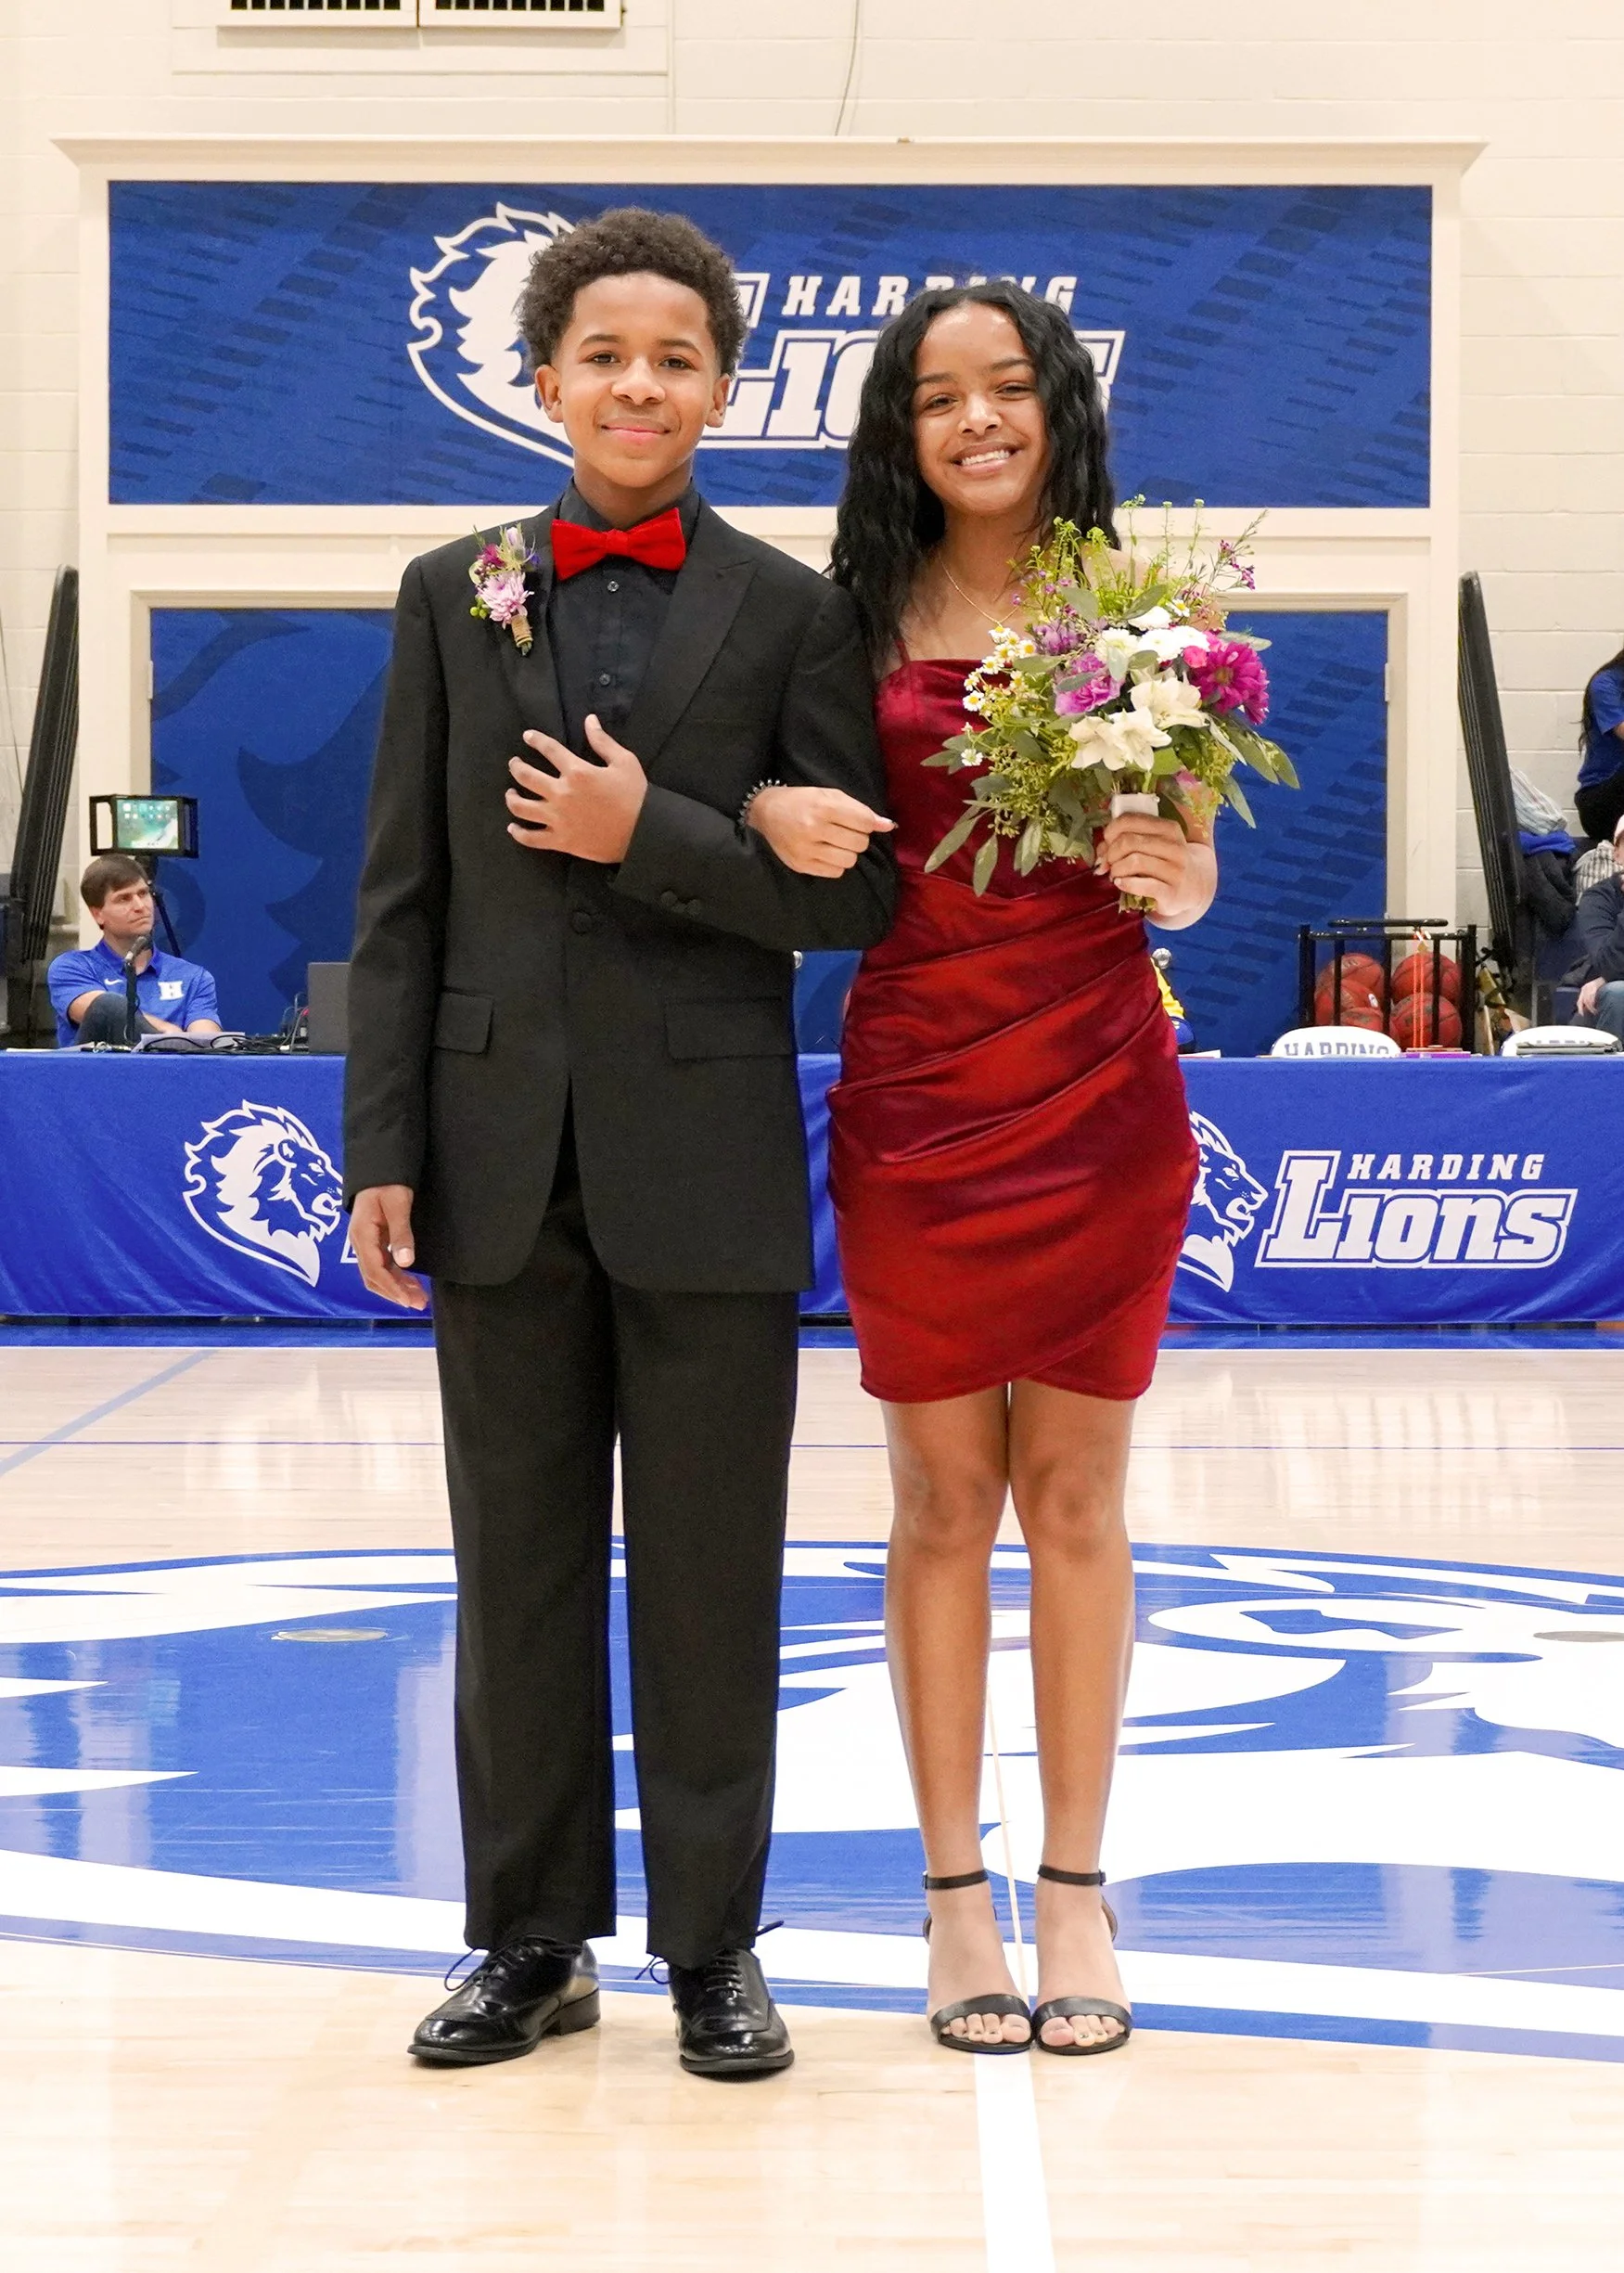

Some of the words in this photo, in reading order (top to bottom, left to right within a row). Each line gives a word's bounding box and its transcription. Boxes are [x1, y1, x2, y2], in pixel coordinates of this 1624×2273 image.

[781, 275, 1077, 316] HARG
[158, 980, 185, 1001] H
[1347, 1153, 1545, 1180] HARDING
